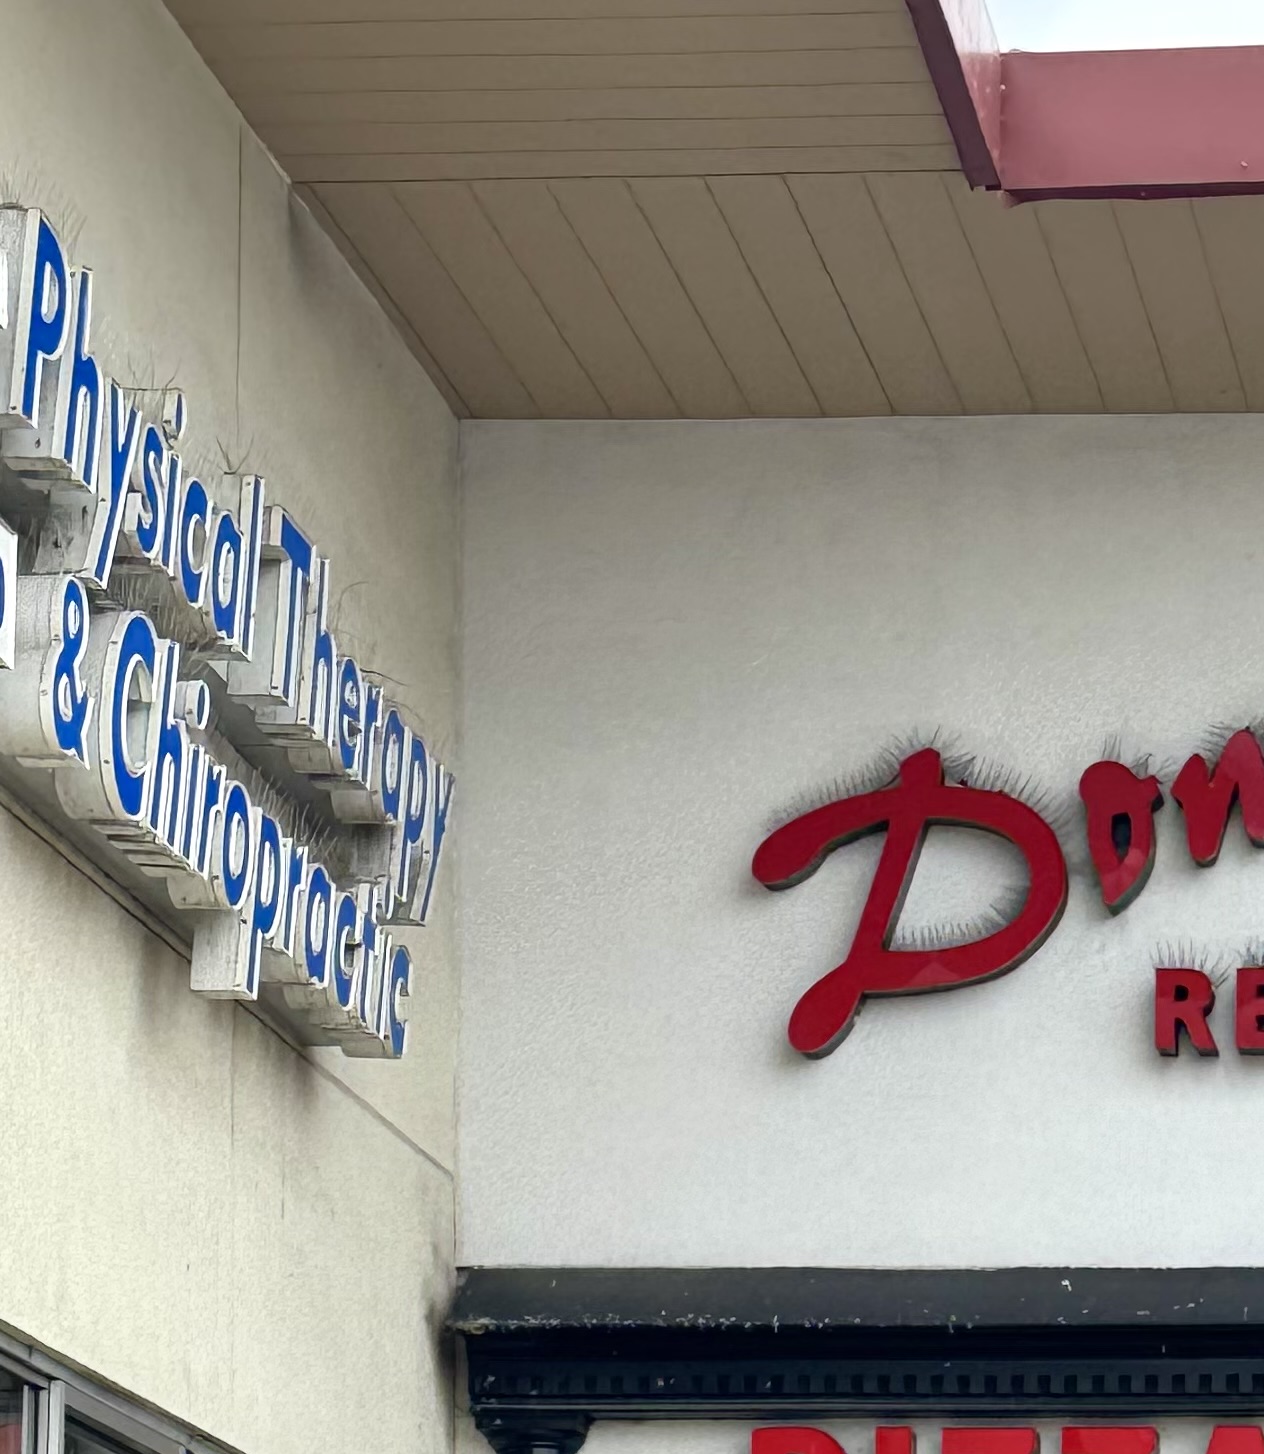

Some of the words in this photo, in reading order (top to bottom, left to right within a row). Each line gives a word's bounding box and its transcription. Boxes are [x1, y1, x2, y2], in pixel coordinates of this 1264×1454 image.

[20, 208, 266, 661] Physical
[268, 504, 456, 924] Therapy
[50, 575, 97, 770] &
[103, 610, 415, 1059] Chiropractic
